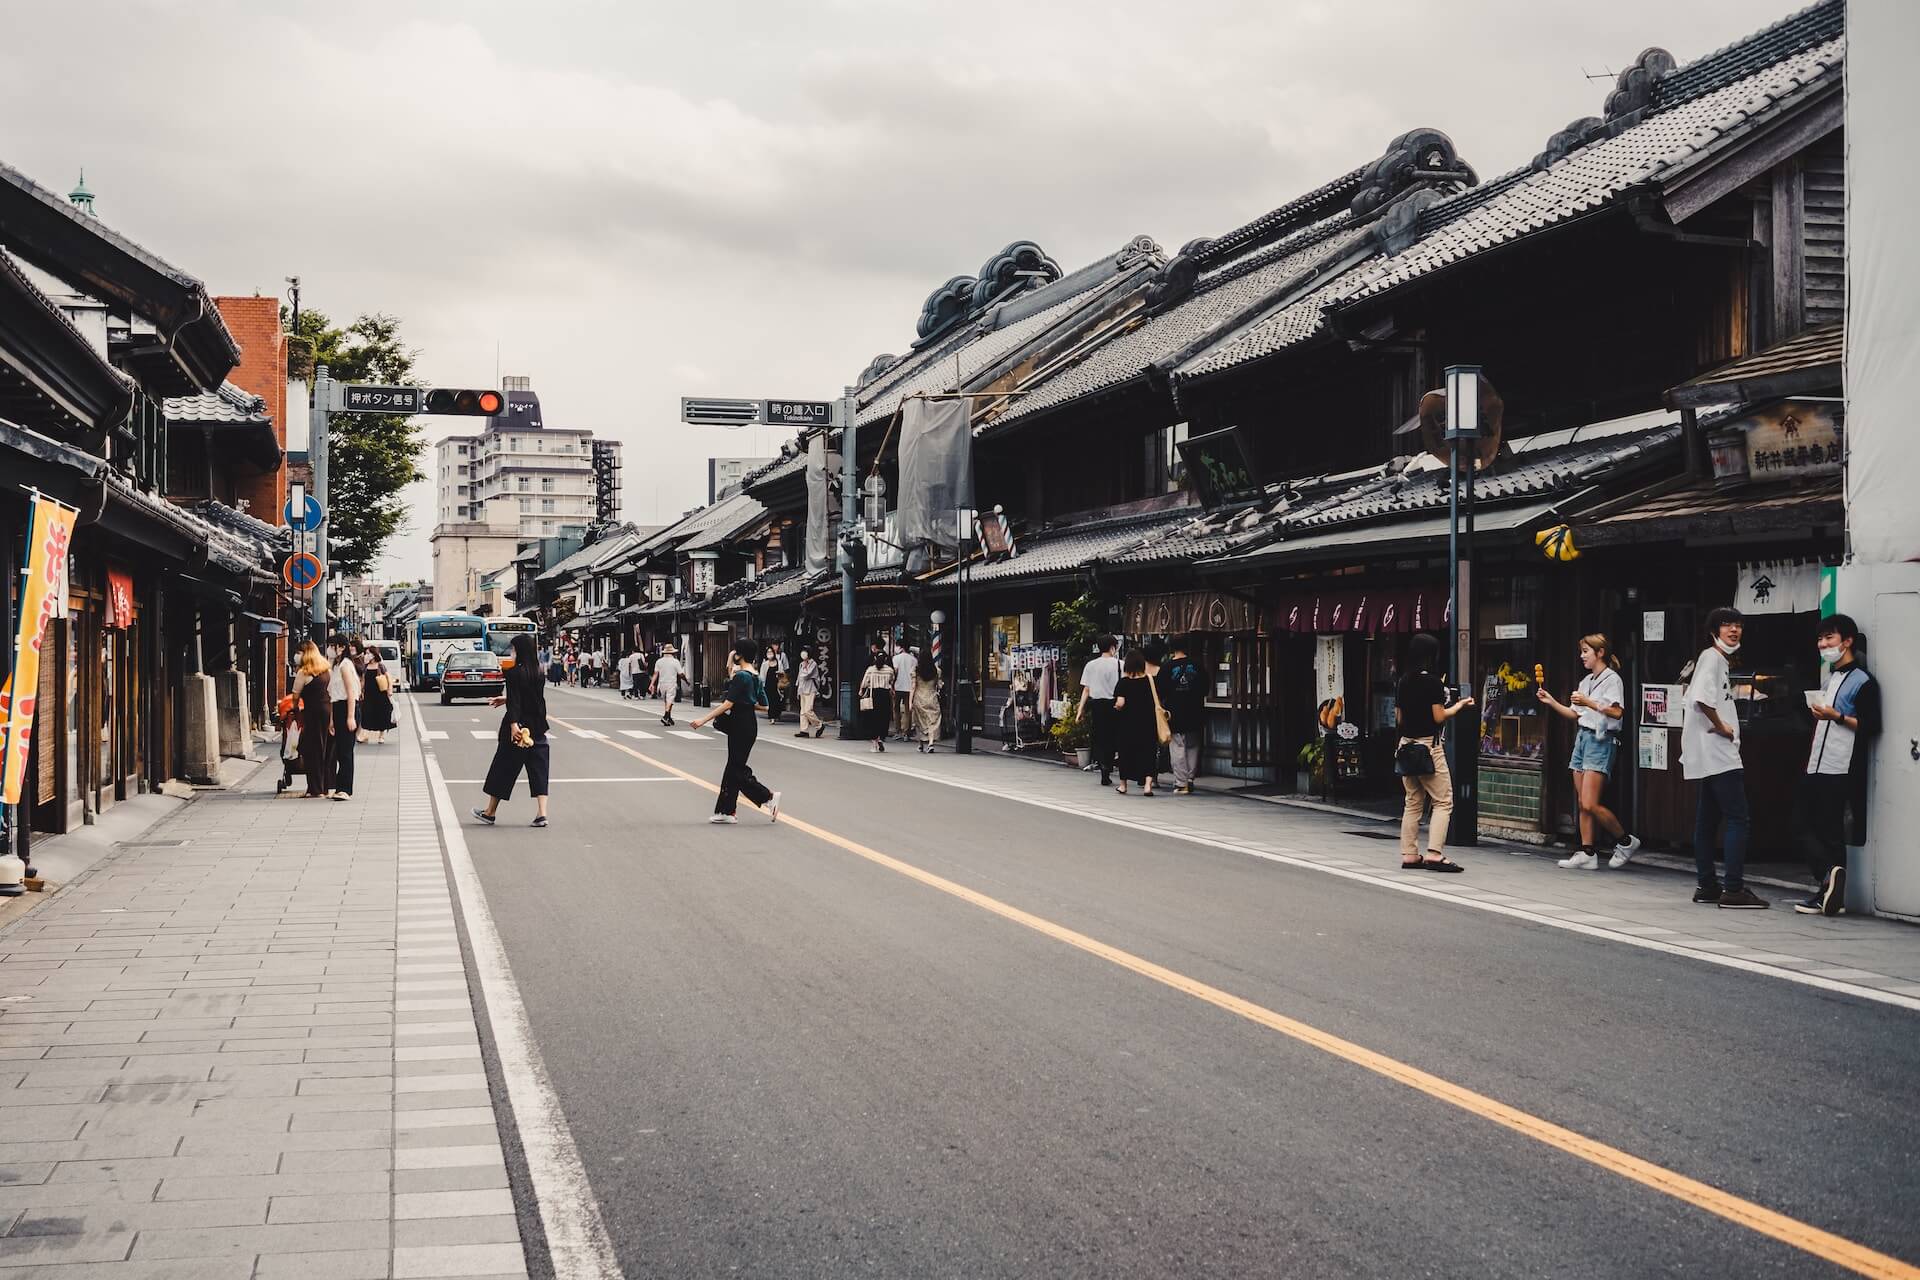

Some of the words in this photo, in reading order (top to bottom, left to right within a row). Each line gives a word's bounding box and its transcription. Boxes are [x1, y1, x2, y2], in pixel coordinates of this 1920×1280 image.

[351, 392, 413, 406] 押ボタン信号
[771, 403, 825, 416] 時の鐘入口
